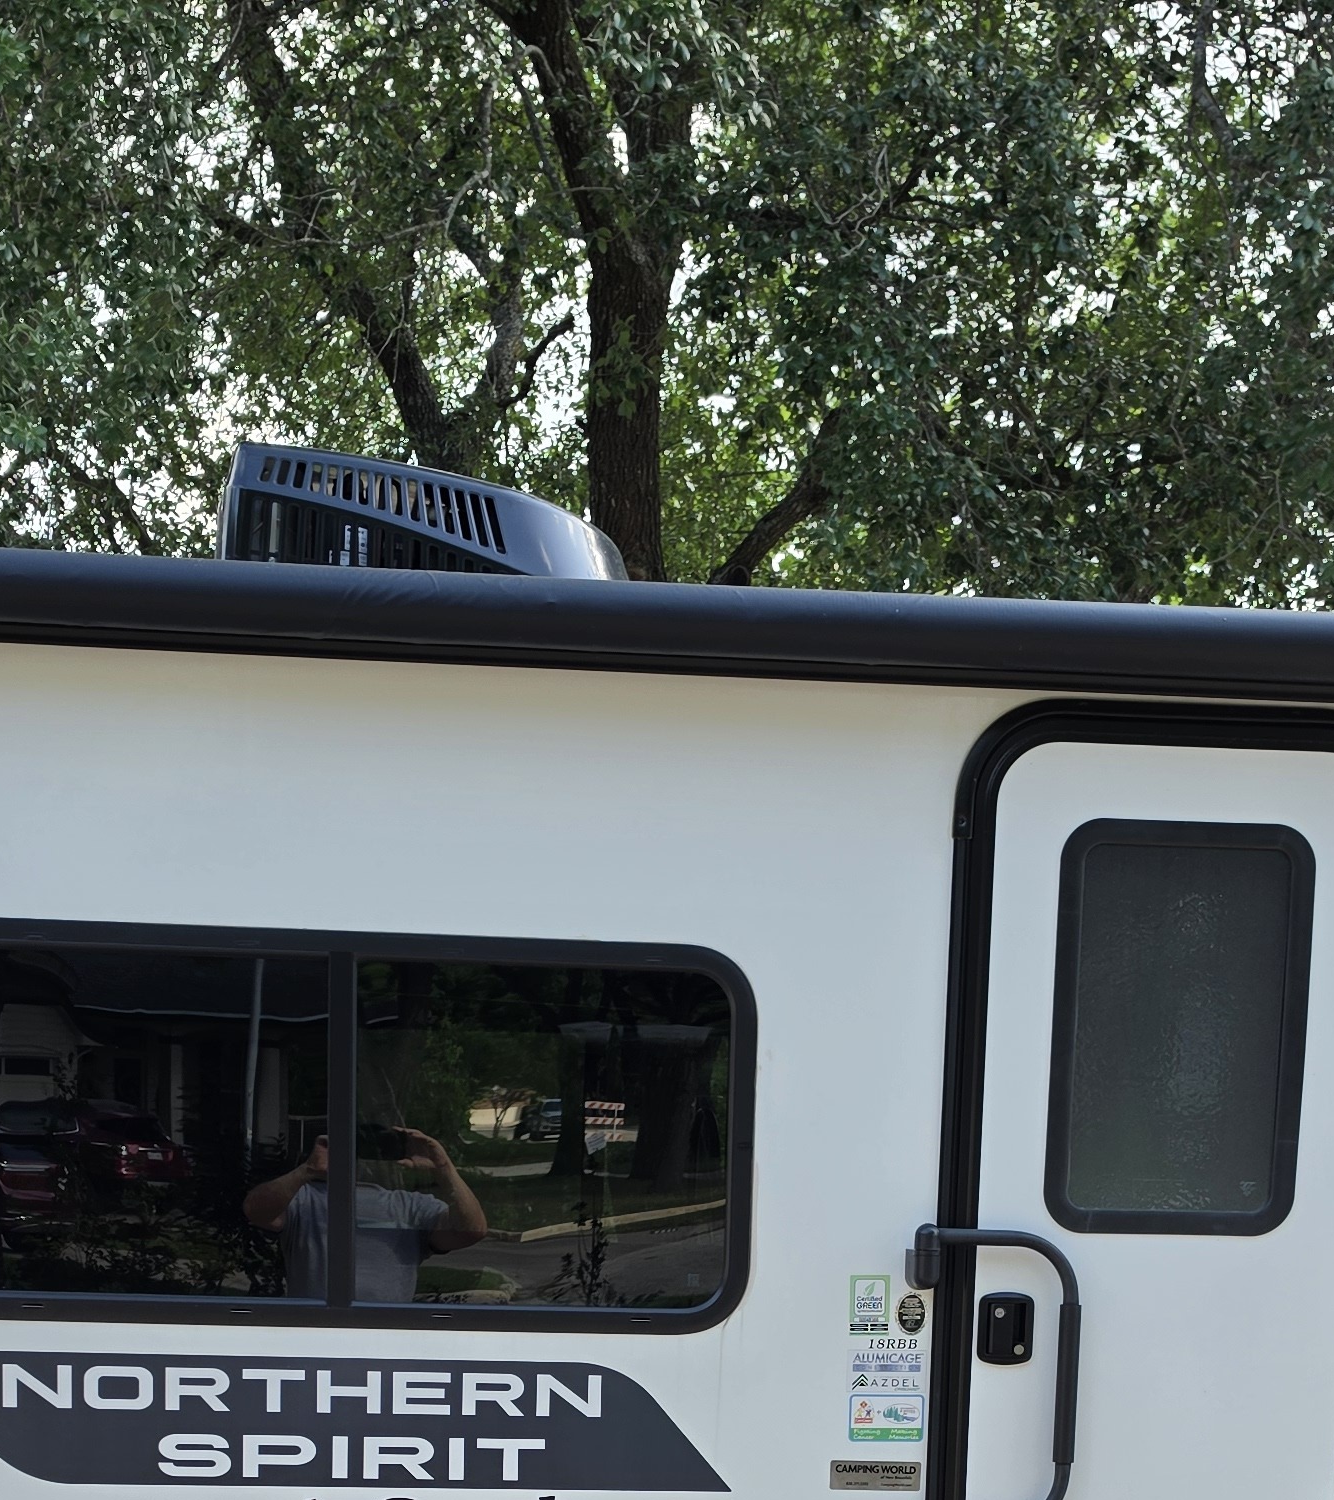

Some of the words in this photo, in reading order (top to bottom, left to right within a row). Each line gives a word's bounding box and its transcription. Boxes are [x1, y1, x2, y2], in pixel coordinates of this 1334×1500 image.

[869, 1339, 918, 1349] 18RBB
[852, 1352, 922, 1363] ALUMICAGE
[870, 1378, 919, 1388] AZDEL
[1, 1363, 603, 1418] NORTHERN
[157, 1433, 546, 1482] SPIRIT
[835, 1464, 879, 1474] CAMPING
[880, 1465, 917, 1475] WORLD
